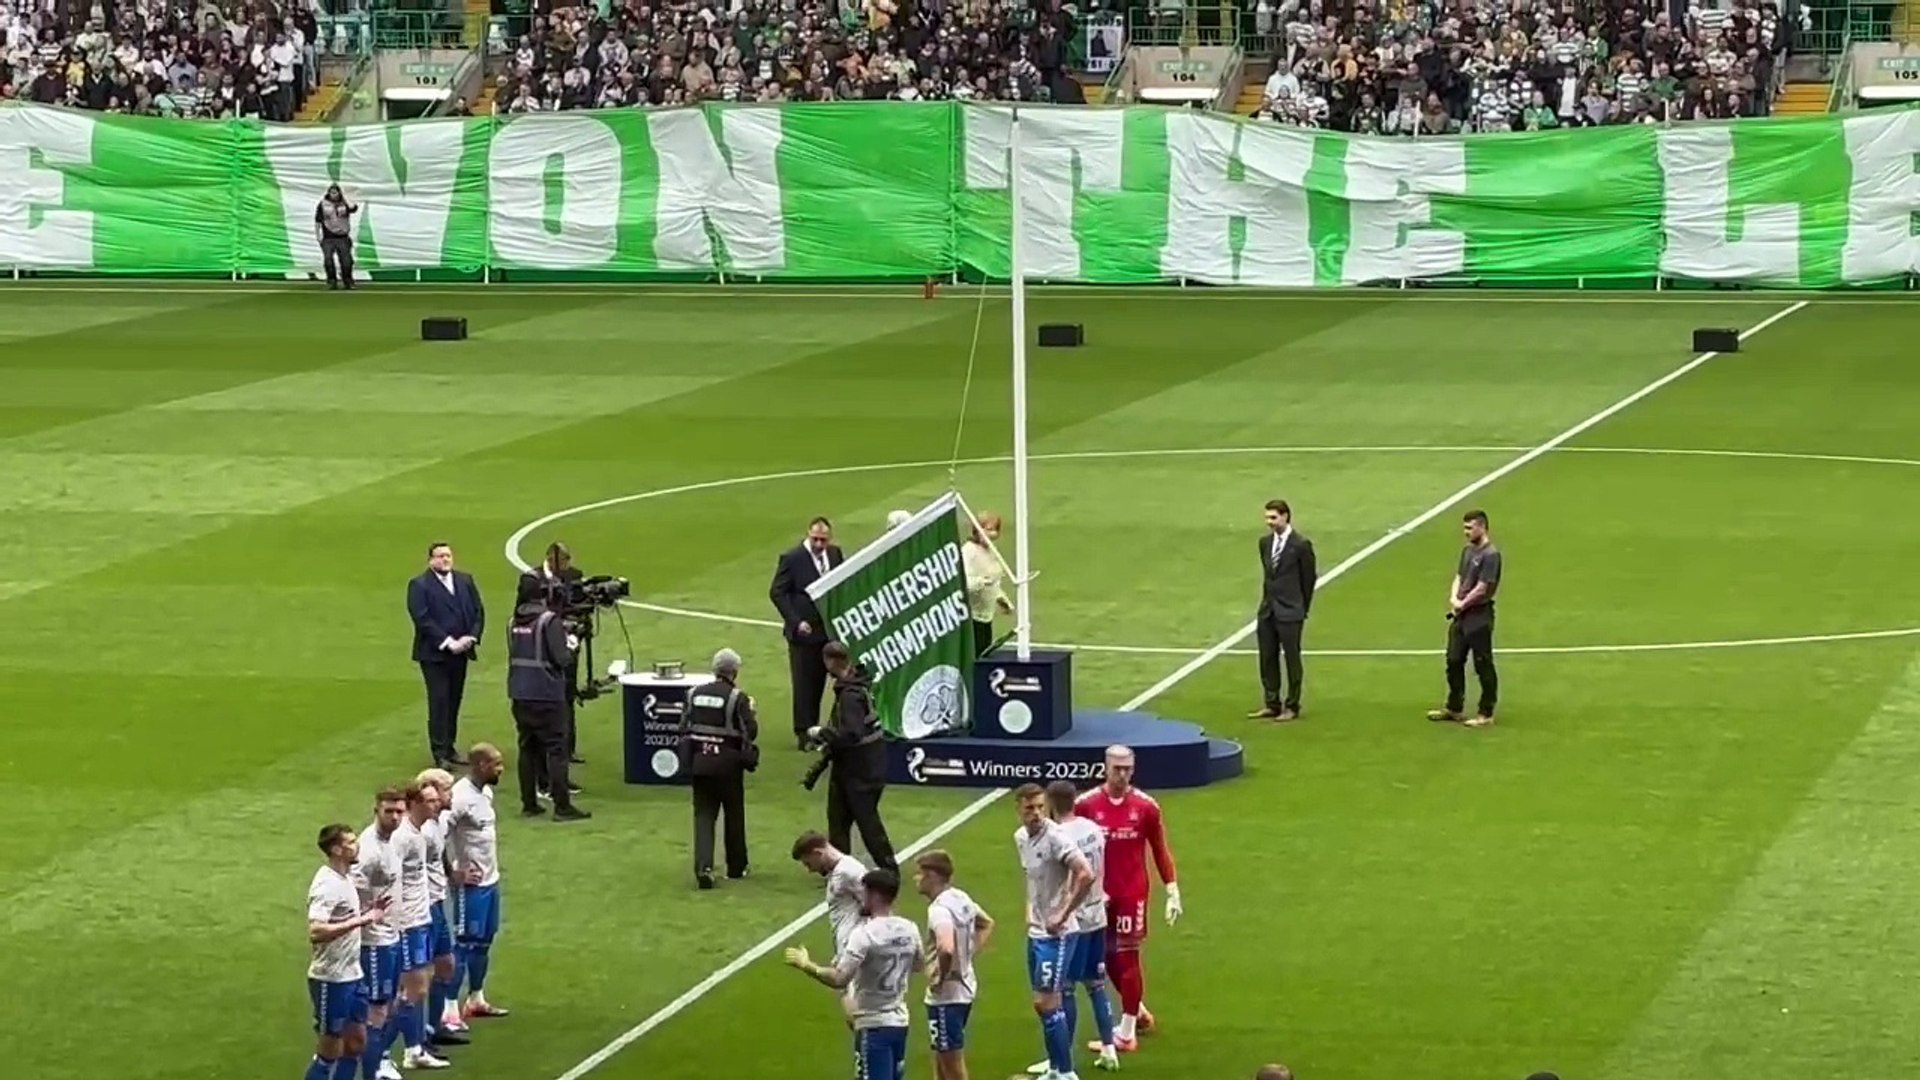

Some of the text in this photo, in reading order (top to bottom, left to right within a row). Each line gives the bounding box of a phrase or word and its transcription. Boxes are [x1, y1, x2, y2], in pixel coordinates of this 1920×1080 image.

[415, 76, 438, 85] 103
[1173, 73, 1196, 82] 104
[1895, 70, 1919, 80] 105
[265, 108, 787, 281] WON
[965, 107, 1466, 286] THE
[831, 541, 960, 648] PREMIERSHIP
[858, 589, 969, 682] CHAMPIONS
[644, 734, 680, 746] 2023/2
[969, 759, 1041, 778] Winners
[1045, 761, 1106, 779] 2023/2
[1041, 960, 1053, 979] 5
